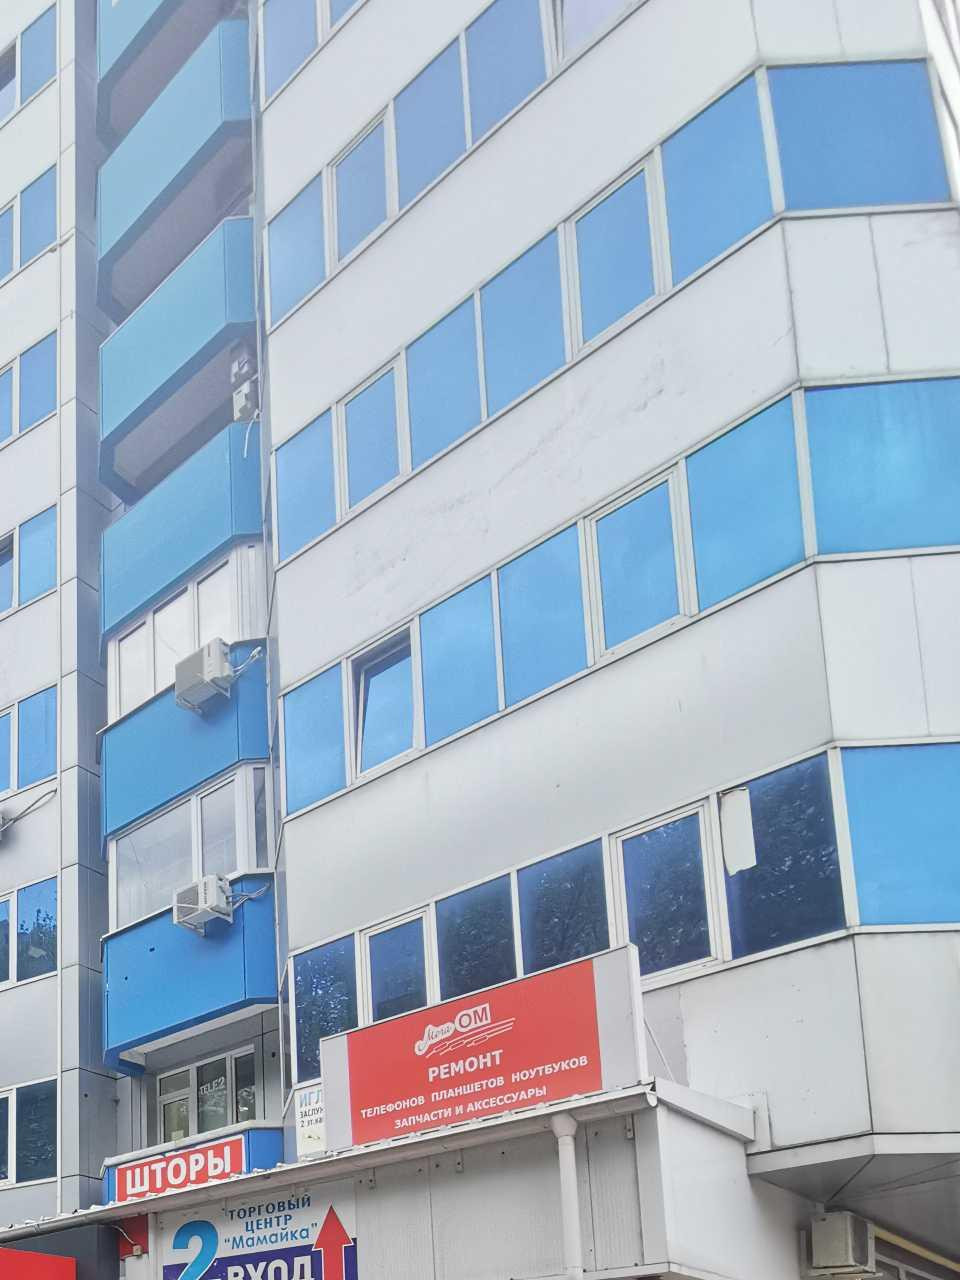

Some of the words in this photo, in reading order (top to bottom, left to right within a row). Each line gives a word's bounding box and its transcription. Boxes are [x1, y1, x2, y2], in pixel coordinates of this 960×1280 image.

[428, 1050, 503, 1082] РЕМОНТ
[199, 1076, 225, 1095] TELE2
[360, 1095, 425, 1119] ТЕЛЕФОНОВ
[431, 1076, 505, 1102] ПЛАНШЕТОВ
[511, 1055, 588, 1083] НОУТБУКОВ
[394, 1108, 452, 1129] ЗАПЧАСТИ
[455, 1104, 464, 1116] И
[466, 1085, 547, 1113] АКСЕССУАРЫ
[126, 1146, 231, 1194] ШТОРЫ
[228, 1194, 311, 1222] ТОРГОВЫЙ
[245, 1214, 293, 1234] ЦЕНТР
